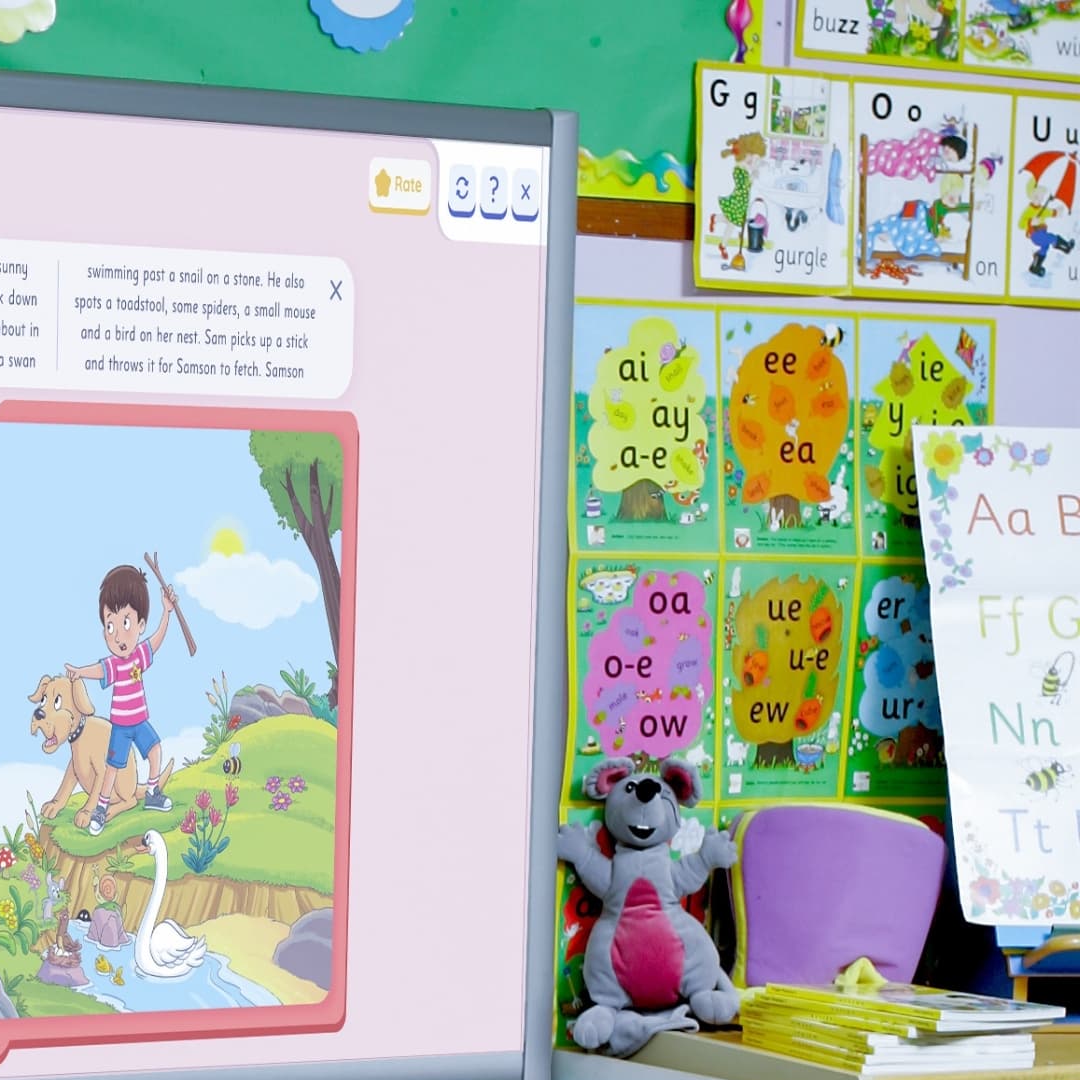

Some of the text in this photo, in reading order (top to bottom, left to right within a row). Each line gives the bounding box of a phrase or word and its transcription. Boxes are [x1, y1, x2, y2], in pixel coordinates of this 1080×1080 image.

[812, 8, 860, 34] buzz
[1056, 36, 1080, 56] wi
[710, 78, 758, 120] G g
[871, 92, 892, 120] O
[1033, 115, 1051, 142] U
[394, 174, 422, 193] Rate
[774, 238, 828, 277] gurgle
[976, 260, 998, 277] on
[87, 264, 305, 289] swimming past a snail on a stone. He also
[8, 288, 38, 307] down
[74, 295, 316, 320] spots a toadstool, some spiders, a small mouse
[30, 322, 40, 338] in
[80, 322, 309, 352] and a bird on her nest. Sam picks up a stick
[8, 355, 36, 368] swan
[84, 354, 304, 379] and throws it for Samson to fetch. Samson
[618, 351, 649, 382] ai
[764, 351, 797, 375] ee
[920, 351, 944, 382] ie
[652, 405, 690, 443] ay
[888, 402, 904, 437] y
[620, 446, 668, 469] a-e
[779, 440, 816, 464] ea
[966, 492, 1035, 537] Aa
[648, 591, 691, 615] oa
[768, 598, 802, 622] ue
[877, 596, 905, 619] er
[978, 595, 1024, 656] Ff
[604, 655, 653, 679] o-e
[676, 659, 698, 673] grow
[789, 648, 830, 670] u-e
[749, 700, 790, 724] ew
[882, 698, 914, 720] ur
[639, 714, 688, 738] ow
[988, 702, 1061, 746] Nn
[998, 808, 1053, 854] Tt
